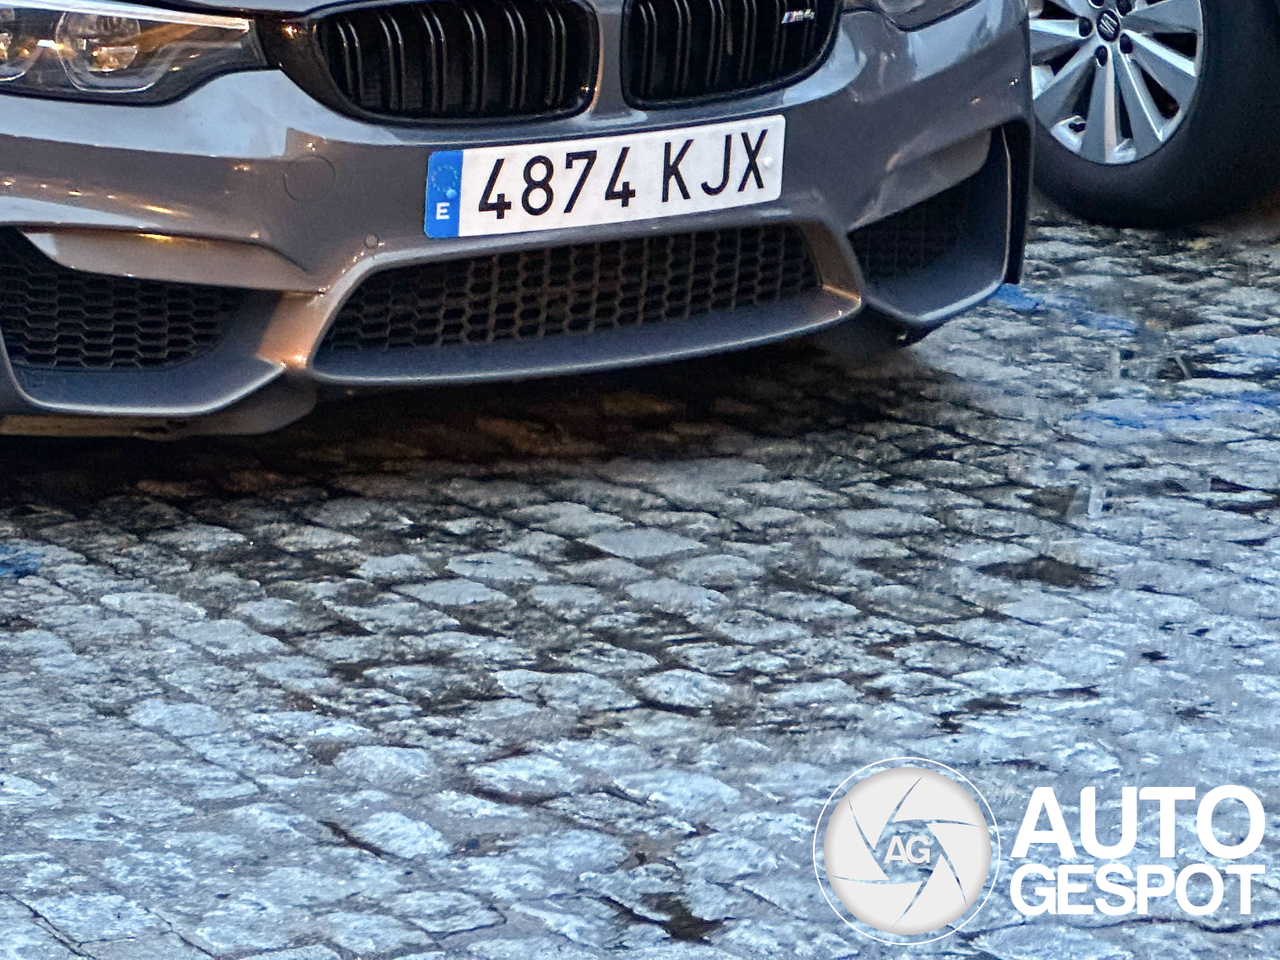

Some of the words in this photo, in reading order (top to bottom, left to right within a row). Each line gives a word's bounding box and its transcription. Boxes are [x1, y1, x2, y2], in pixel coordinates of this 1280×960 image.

[477, 146, 637, 220] 4874
[661, 128, 769, 203] KJX
[435, 202, 451, 221] E
